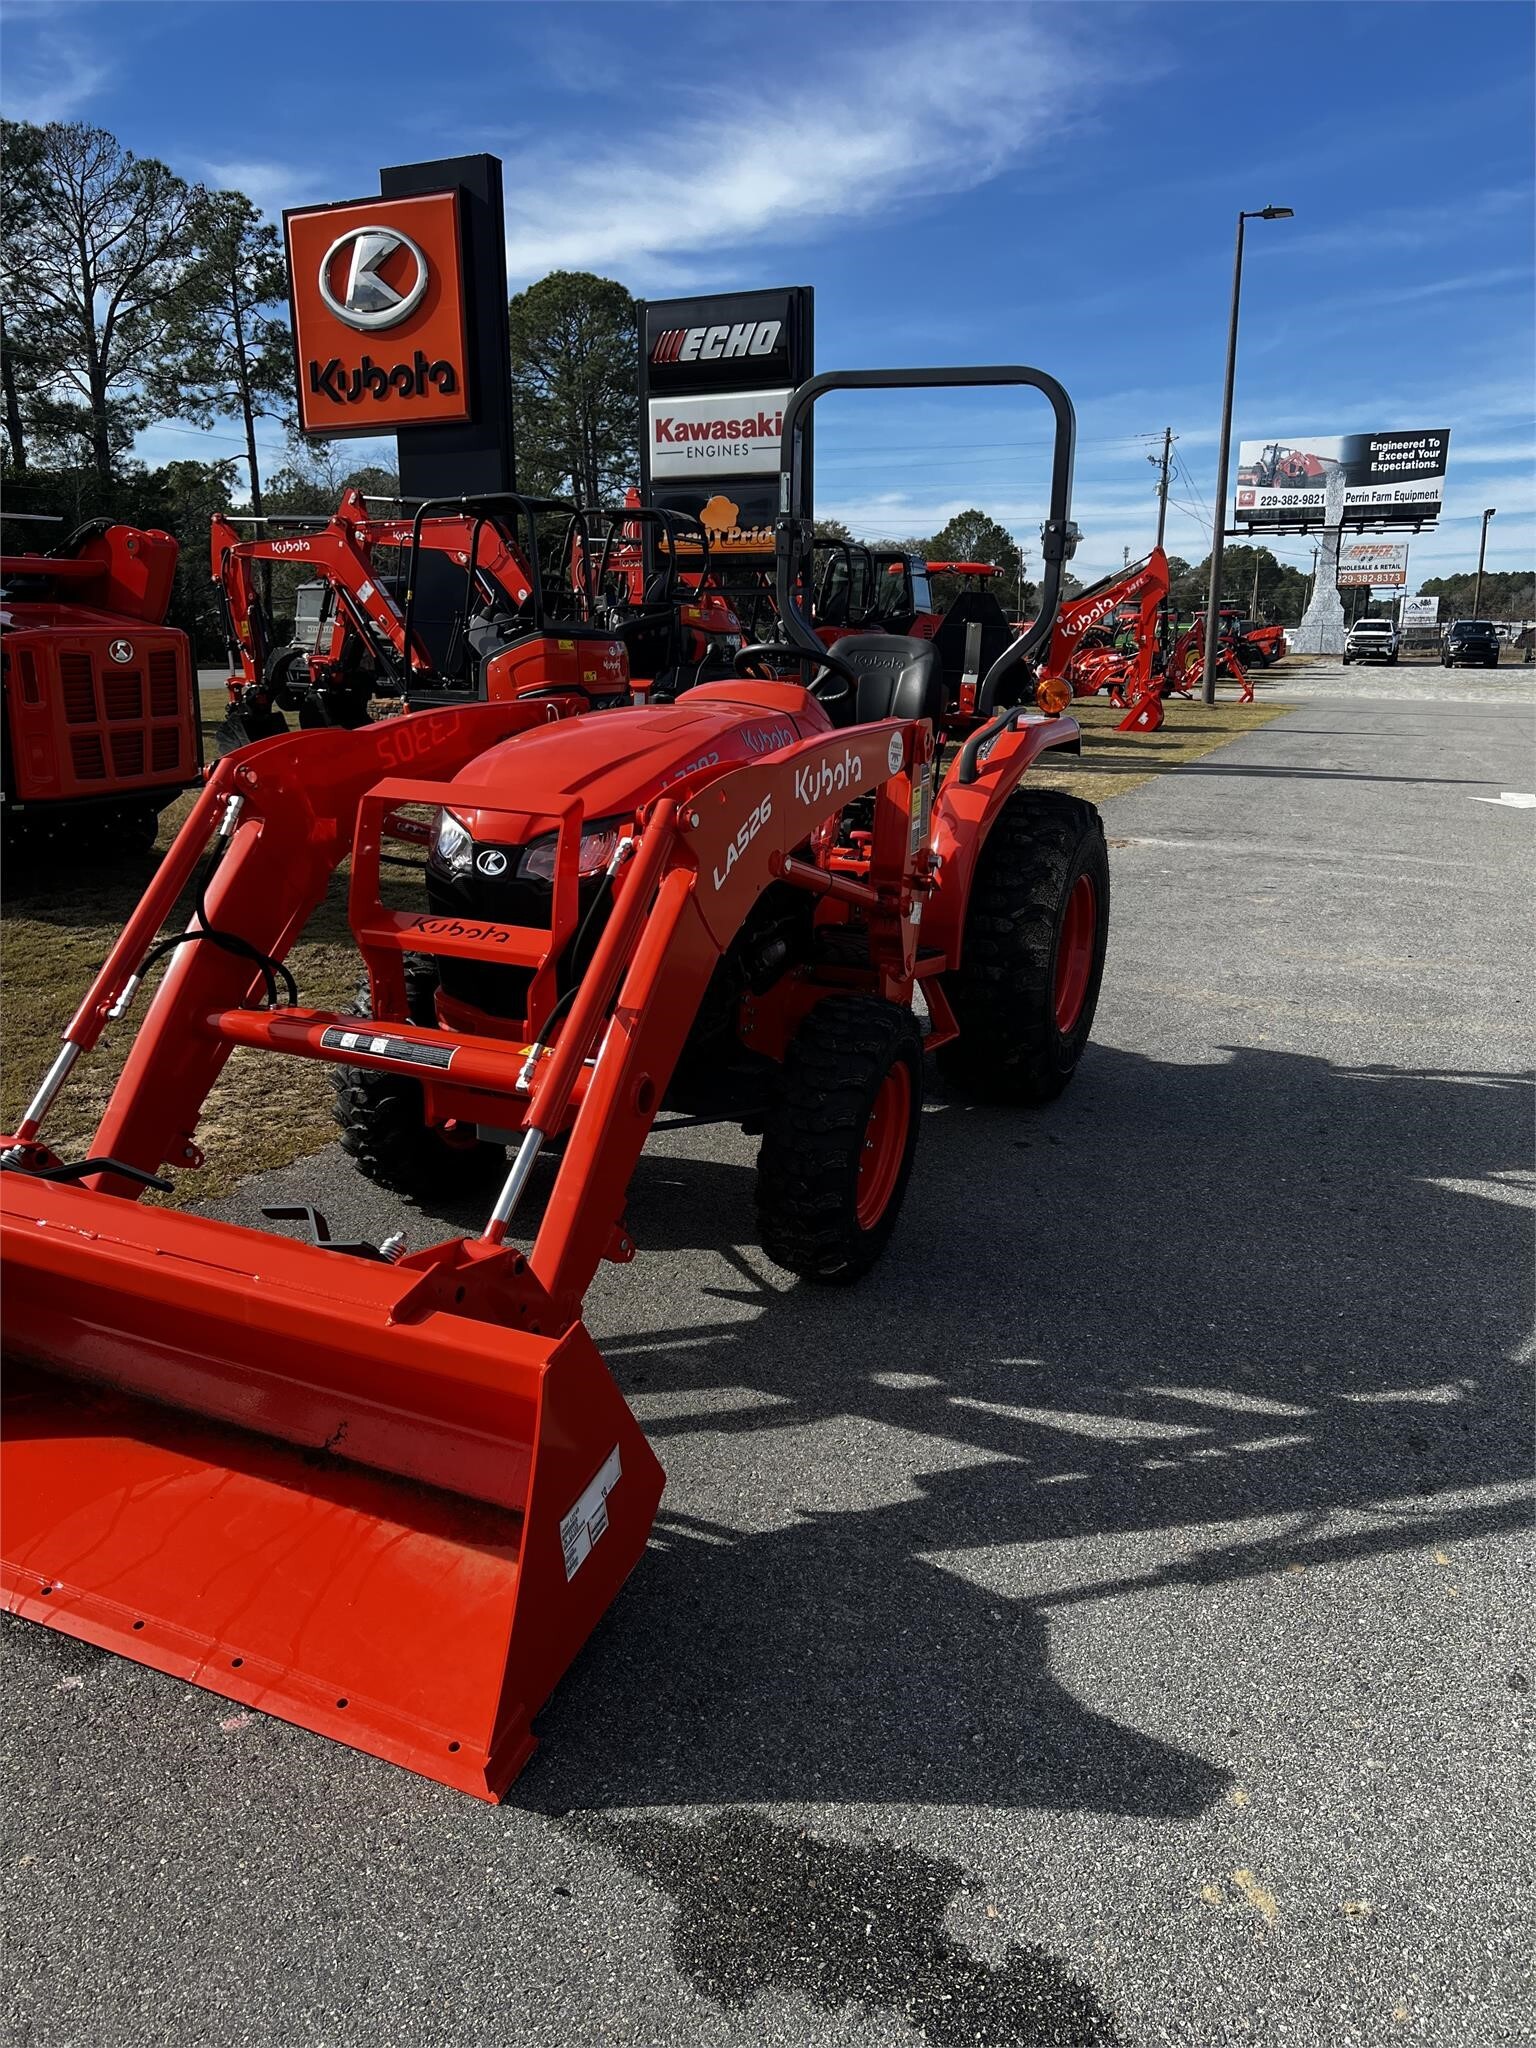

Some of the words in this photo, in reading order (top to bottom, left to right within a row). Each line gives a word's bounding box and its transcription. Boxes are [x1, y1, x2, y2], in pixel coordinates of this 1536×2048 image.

[679, 320, 782, 362] ECHO
[308, 351, 456, 402] Kubota
[656, 411, 783, 443] Kawasaki
[687, 444, 749, 458] ENGINES
[1370, 438, 1426, 452] Engineered
[1428, 438, 1440, 448] To
[1378, 450, 1415, 461] Exceed
[1418, 449, 1440, 459] Your
[1370, 460, 1439, 472] Expectations.
[1260, 494, 1325, 506] 229-382-9821
[1345, 491, 1369, 503] Perrin
[1371, 491, 1392, 502] Farm
[1394, 489, 1438, 503] Equipment
[271, 539, 311, 554] Kubota
[1060, 598, 1115, 637] Kubota
[854, 655, 904, 670] Kubota
[740, 724, 794, 753] Kubota
[795, 749, 862, 805] Kubota
[713, 793, 772, 891] LA526
[411, 916, 510, 943] Kubota
